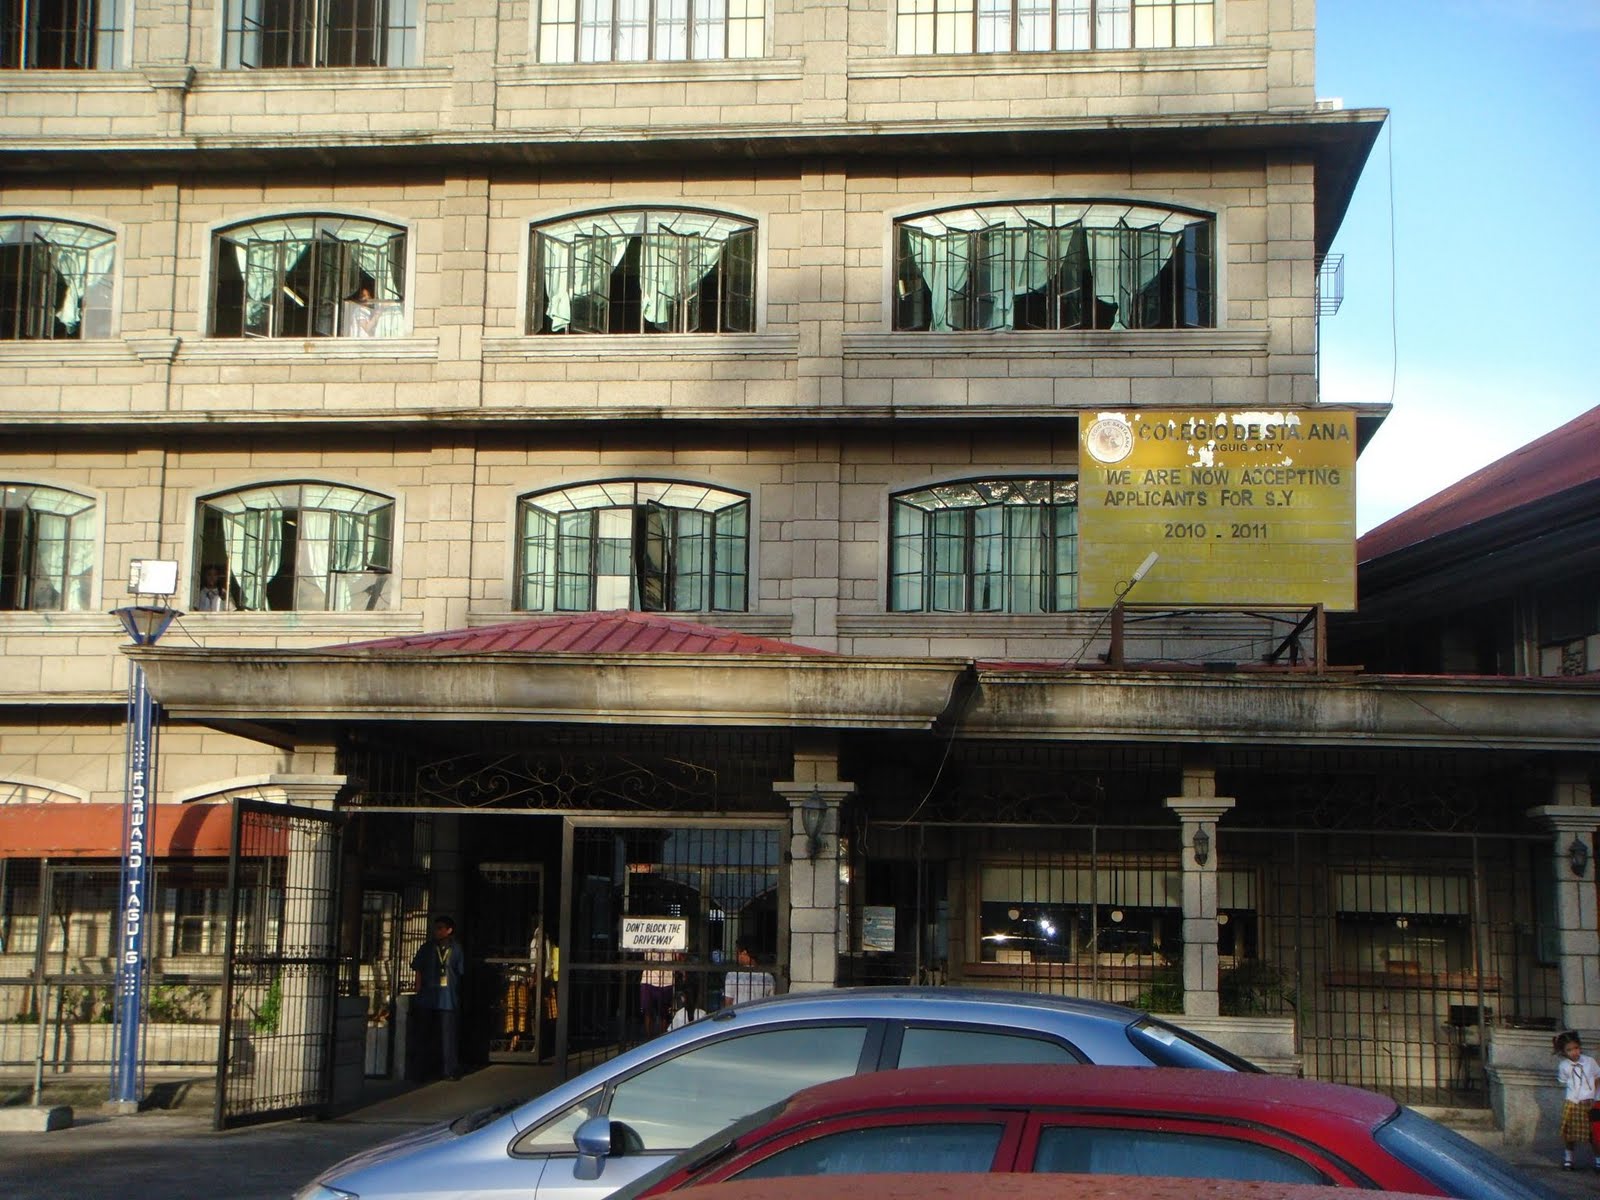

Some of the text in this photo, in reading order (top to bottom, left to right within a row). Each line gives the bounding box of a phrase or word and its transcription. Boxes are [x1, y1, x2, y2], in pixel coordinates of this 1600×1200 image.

[1139, 423, 1228, 440] COLEGIO
[1234, 424, 1260, 440] DE
[1308, 424, 1349, 440] ANA
[1206, 443, 1284, 452] TAGUIG CITY
[1106, 469, 1340, 485] WE ARE NOW ACCEPTING
[1104, 490, 1207, 506] APPLICANTS
[1220, 489, 1253, 506] FOR
[1164, 523, 1206, 538] 2010
[1231, 523, 1267, 538] 2011
[125, 771, 145, 964] FORWARD TAGUIG
[645, 923, 667, 934] BLOCK
[668, 923, 681, 933] THE
[633, 935, 674, 945] DRIVEWAY
